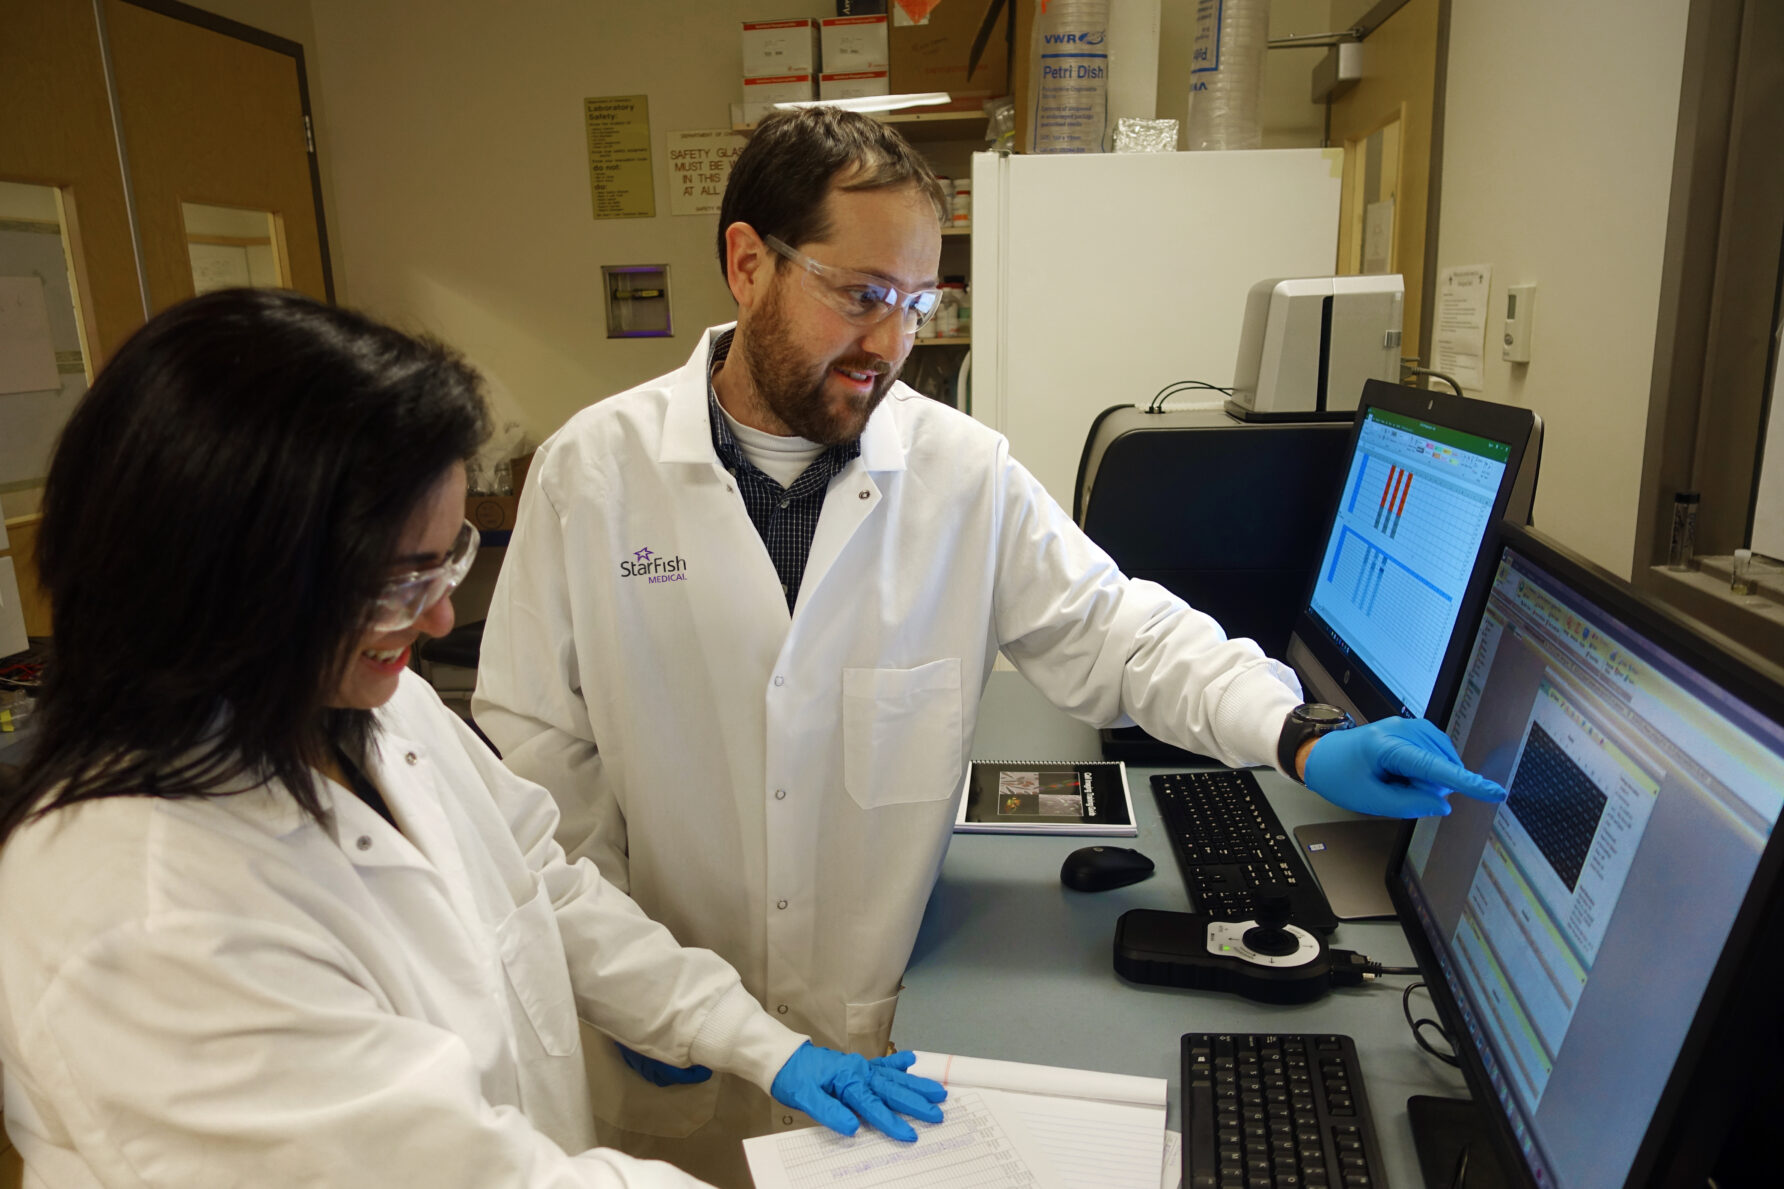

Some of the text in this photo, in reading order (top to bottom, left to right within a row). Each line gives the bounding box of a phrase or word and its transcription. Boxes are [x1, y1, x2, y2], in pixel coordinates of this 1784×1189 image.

[1044, 34, 1077, 44] VWR
[1043, 64, 1104, 79] Petri Dish
[588, 103, 635, 112] Laboratory
[670, 148, 711, 160] SAFETY
[674, 161, 704, 172] MUST
[709, 160, 724, 170] BE
[682, 174, 722, 184] IN THIS
[683, 185, 720, 197] AT ALL
[620, 555, 687, 578] StarFish
[648, 573, 687, 584] MEDICAL
